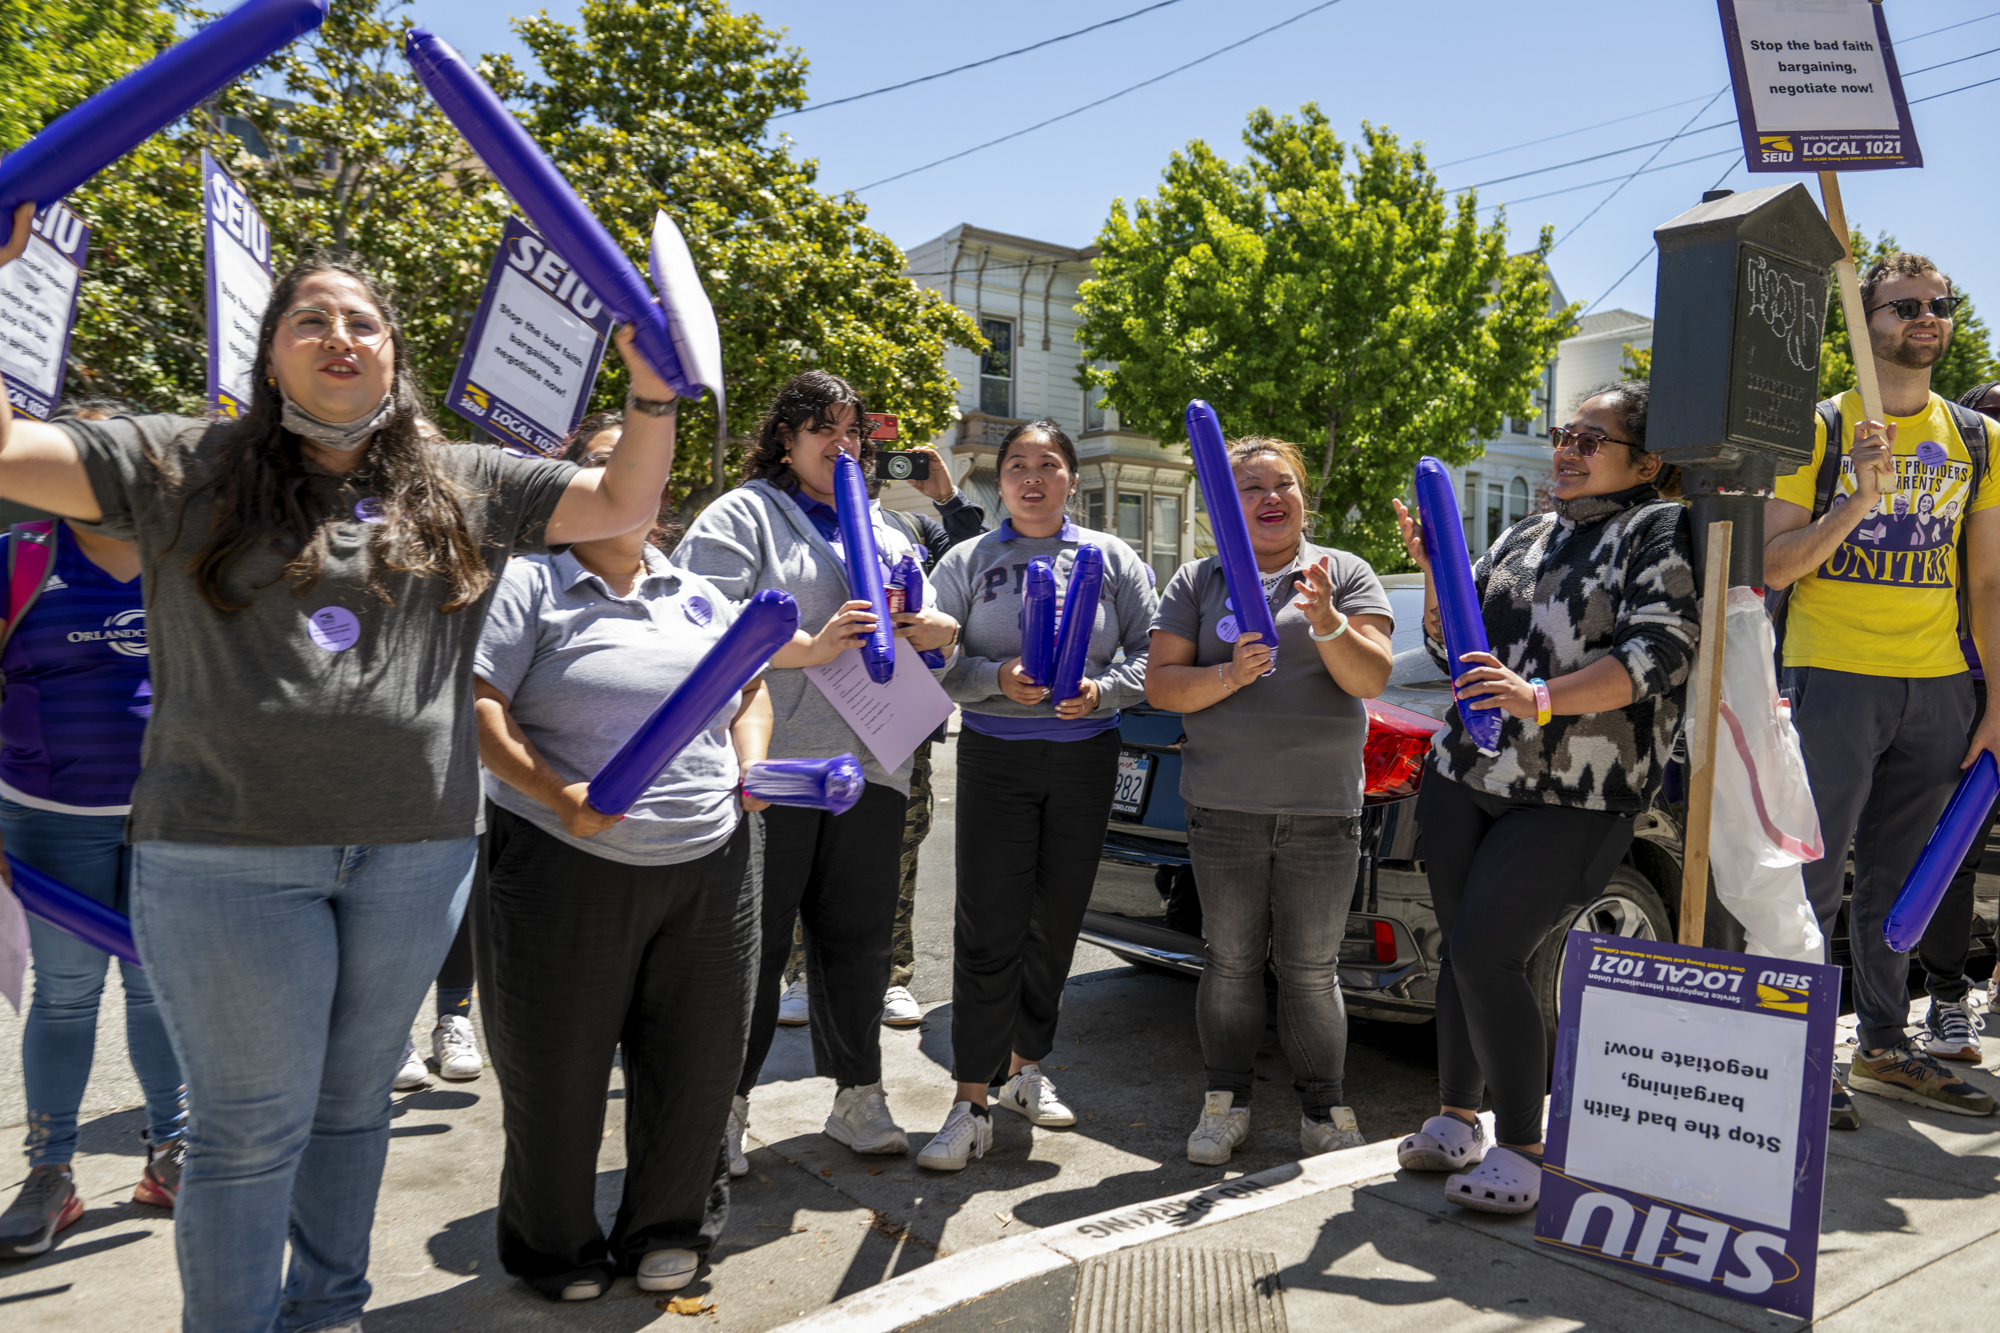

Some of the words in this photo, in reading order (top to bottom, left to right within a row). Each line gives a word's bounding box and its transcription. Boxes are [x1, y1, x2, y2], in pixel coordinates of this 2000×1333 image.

[1750, 40, 1784, 53] Stop
[1786, 40, 1810, 51] the
[1814, 40, 1839, 51] bad
[1842, 40, 1874, 52] faith
[1778, 61, 1857, 74] bargaining,
[1769, 82, 1837, 96] negotiate
[1841, 83, 1874, 94] now!
[1762, 152, 1794, 163] SEIU
[1803, 142, 1860, 156] LOCAL
[1865, 141, 1901, 154] 1021
[32, 200, 84, 253] IU
[211, 173, 267, 263] SEIU
[508, 235, 603, 319] SEIU
[498, 303, 523, 326] Stop
[524, 321, 542, 338] the
[542, 332, 562, 352] bad
[561, 344, 583, 368] faith
[508, 332, 563, 376] bargaining,
[494, 346, 542, 382] negotiate
[543, 377, 567, 398] now!
[459, 398, 487, 417] SEIU
[490, 408, 534, 444] LOCAL
[1906, 460, 1968, 482] PROVIDERS
[1895, 475, 1942, 492] ARENTS
[1825, 541, 1954, 584] UNITED
[1593, 946, 1619, 954] California
[1620, 950, 1644, 958] Northern
[1653, 954, 1672, 962] United
[1590, 954, 1645, 976] 1021
[1686, 958, 1705, 967] Strong
[1588, 973, 1611, 982] Union
[1614, 977, 1664, 991] International
[1655, 963, 1743, 992] LOCAL
[1758, 970, 1812, 990] SEIU
[1666, 985, 1709, 998] Employees
[1710, 993, 1741, 1003] Service
[1604, 1041, 1654, 1060] now!
[1661, 1051, 1769, 1081] negotiate
[1621, 1072, 1744, 1112] bargaining,
[1584, 1098, 1631, 1122] faith
[1637, 1110, 1677, 1132] bad
[1684, 1117, 1721, 1140] the
[1728, 1126, 1782, 1153] Stop
[1561, 1191, 1787, 1295] SEIU
